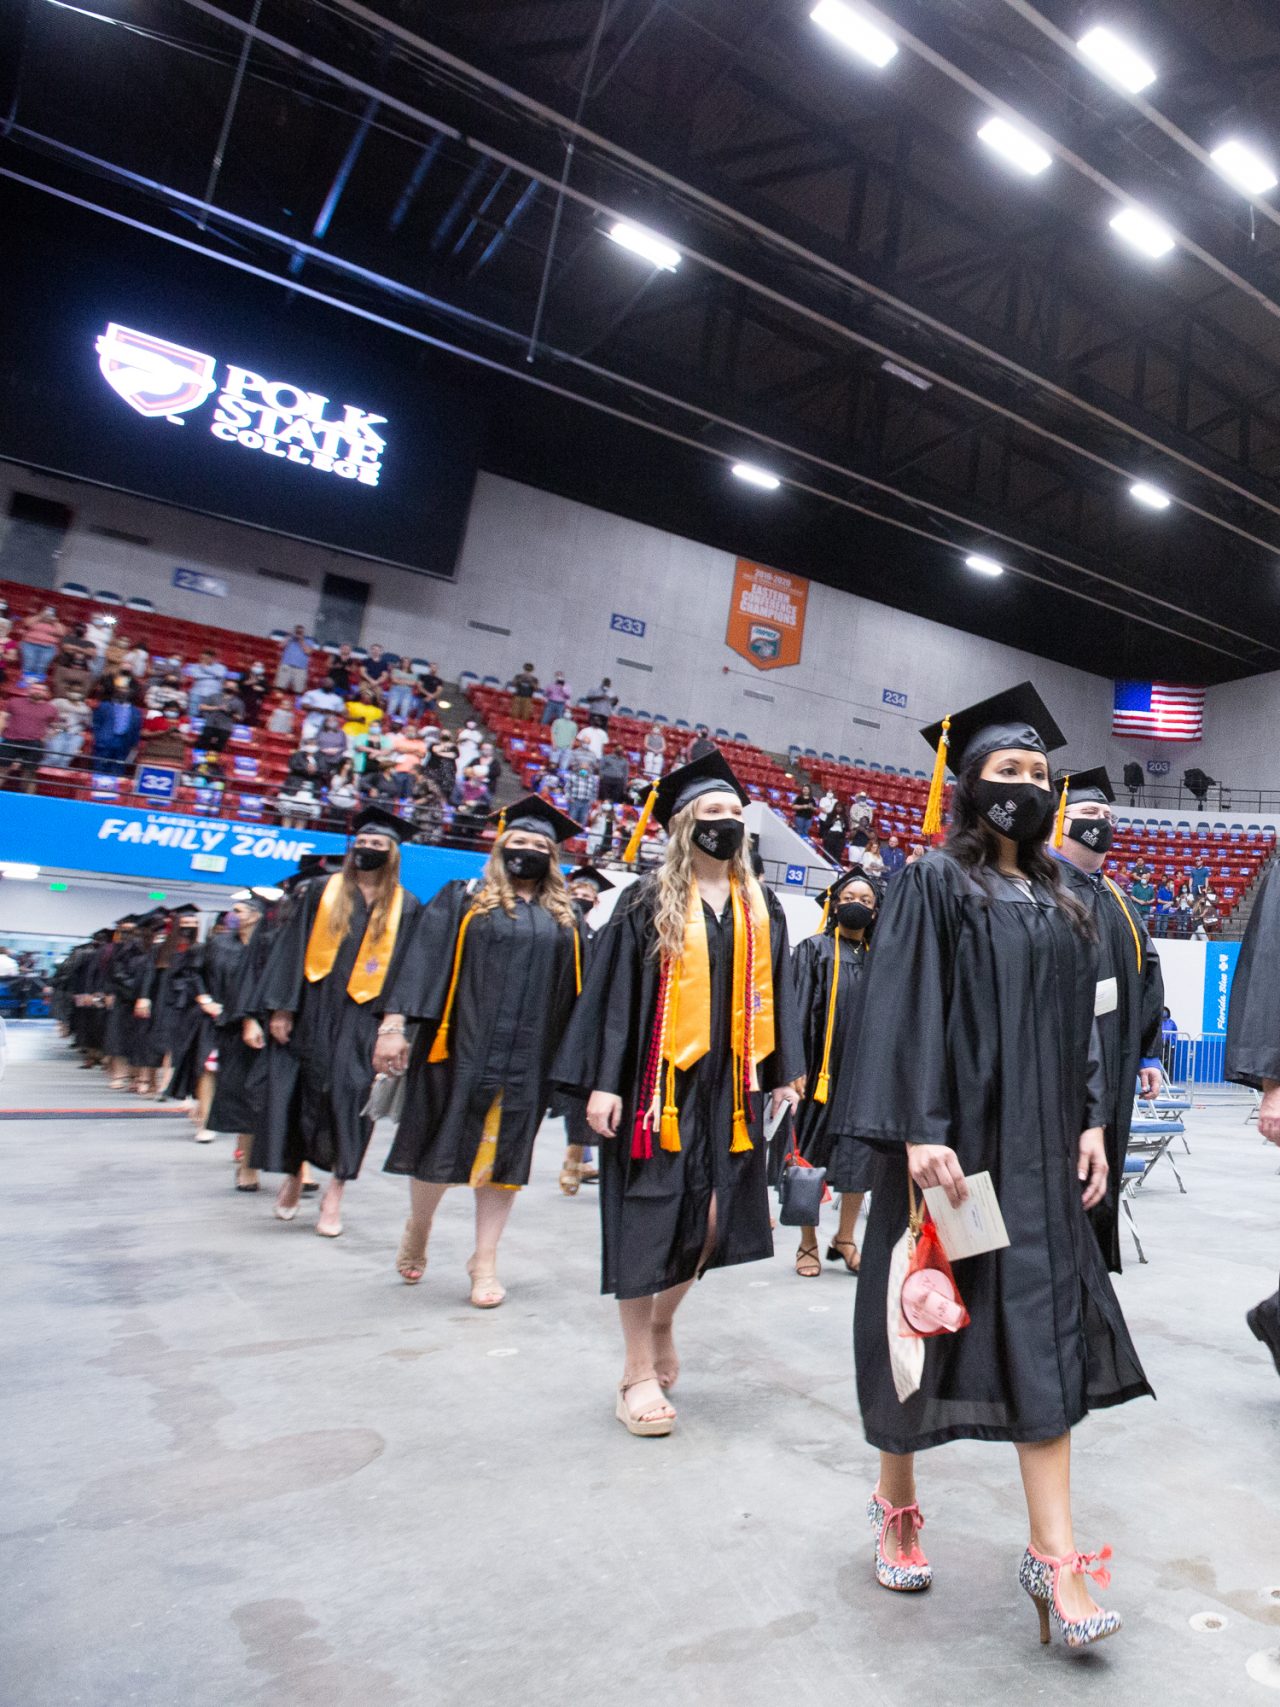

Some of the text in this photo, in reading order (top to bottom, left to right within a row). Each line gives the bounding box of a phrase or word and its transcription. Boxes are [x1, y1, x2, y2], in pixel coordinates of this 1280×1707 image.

[221, 364, 388, 445] POLK
[214, 394, 384, 470] STATE
[211, 422, 380, 487] COLLEGE
[741, 590, 797, 616] CONFERENCE
[751, 583, 790, 603] EASTERN
[613, 616, 643, 635] 233
[740, 601, 798, 626] CHAMPIONS
[885, 691, 906, 707] 234
[1149, 761, 1168, 771] 203
[142, 774, 172, 791] 32
[98, 818, 316, 862] FAMILY ZONE
[787, 868, 804, 882] 33
[1216, 972, 1228, 1031] Florida Blue
